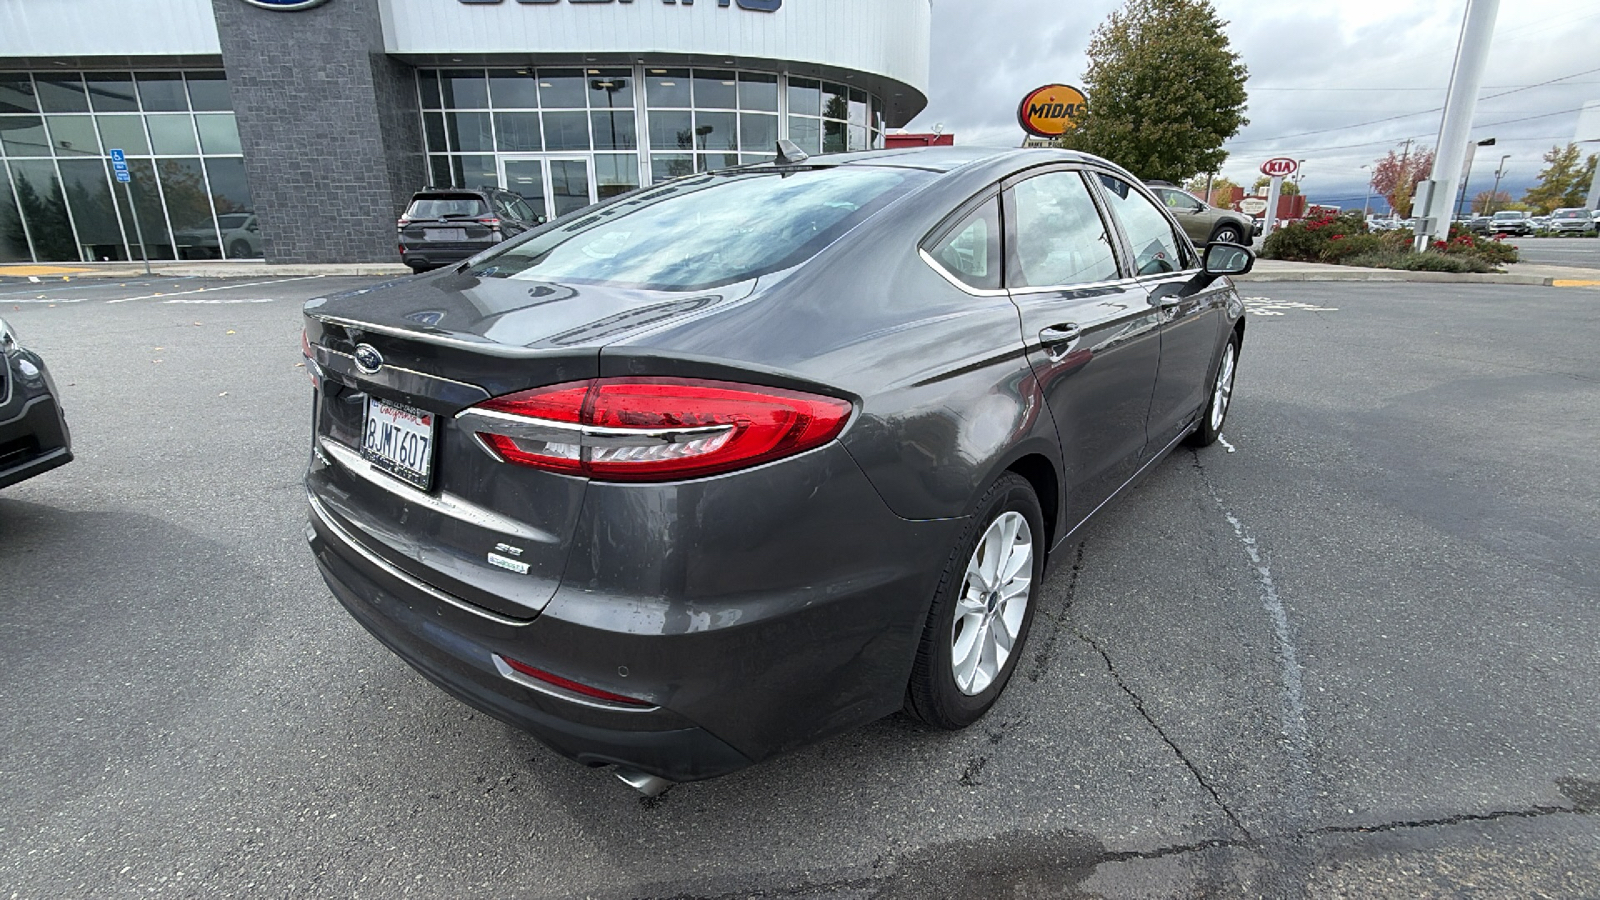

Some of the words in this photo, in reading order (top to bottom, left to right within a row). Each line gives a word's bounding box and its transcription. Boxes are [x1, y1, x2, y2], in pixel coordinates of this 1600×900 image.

[1028, 103, 1085, 118] MIDAS
[1269, 161, 1290, 172] KIA
[367, 417, 428, 472] 8JMT607
